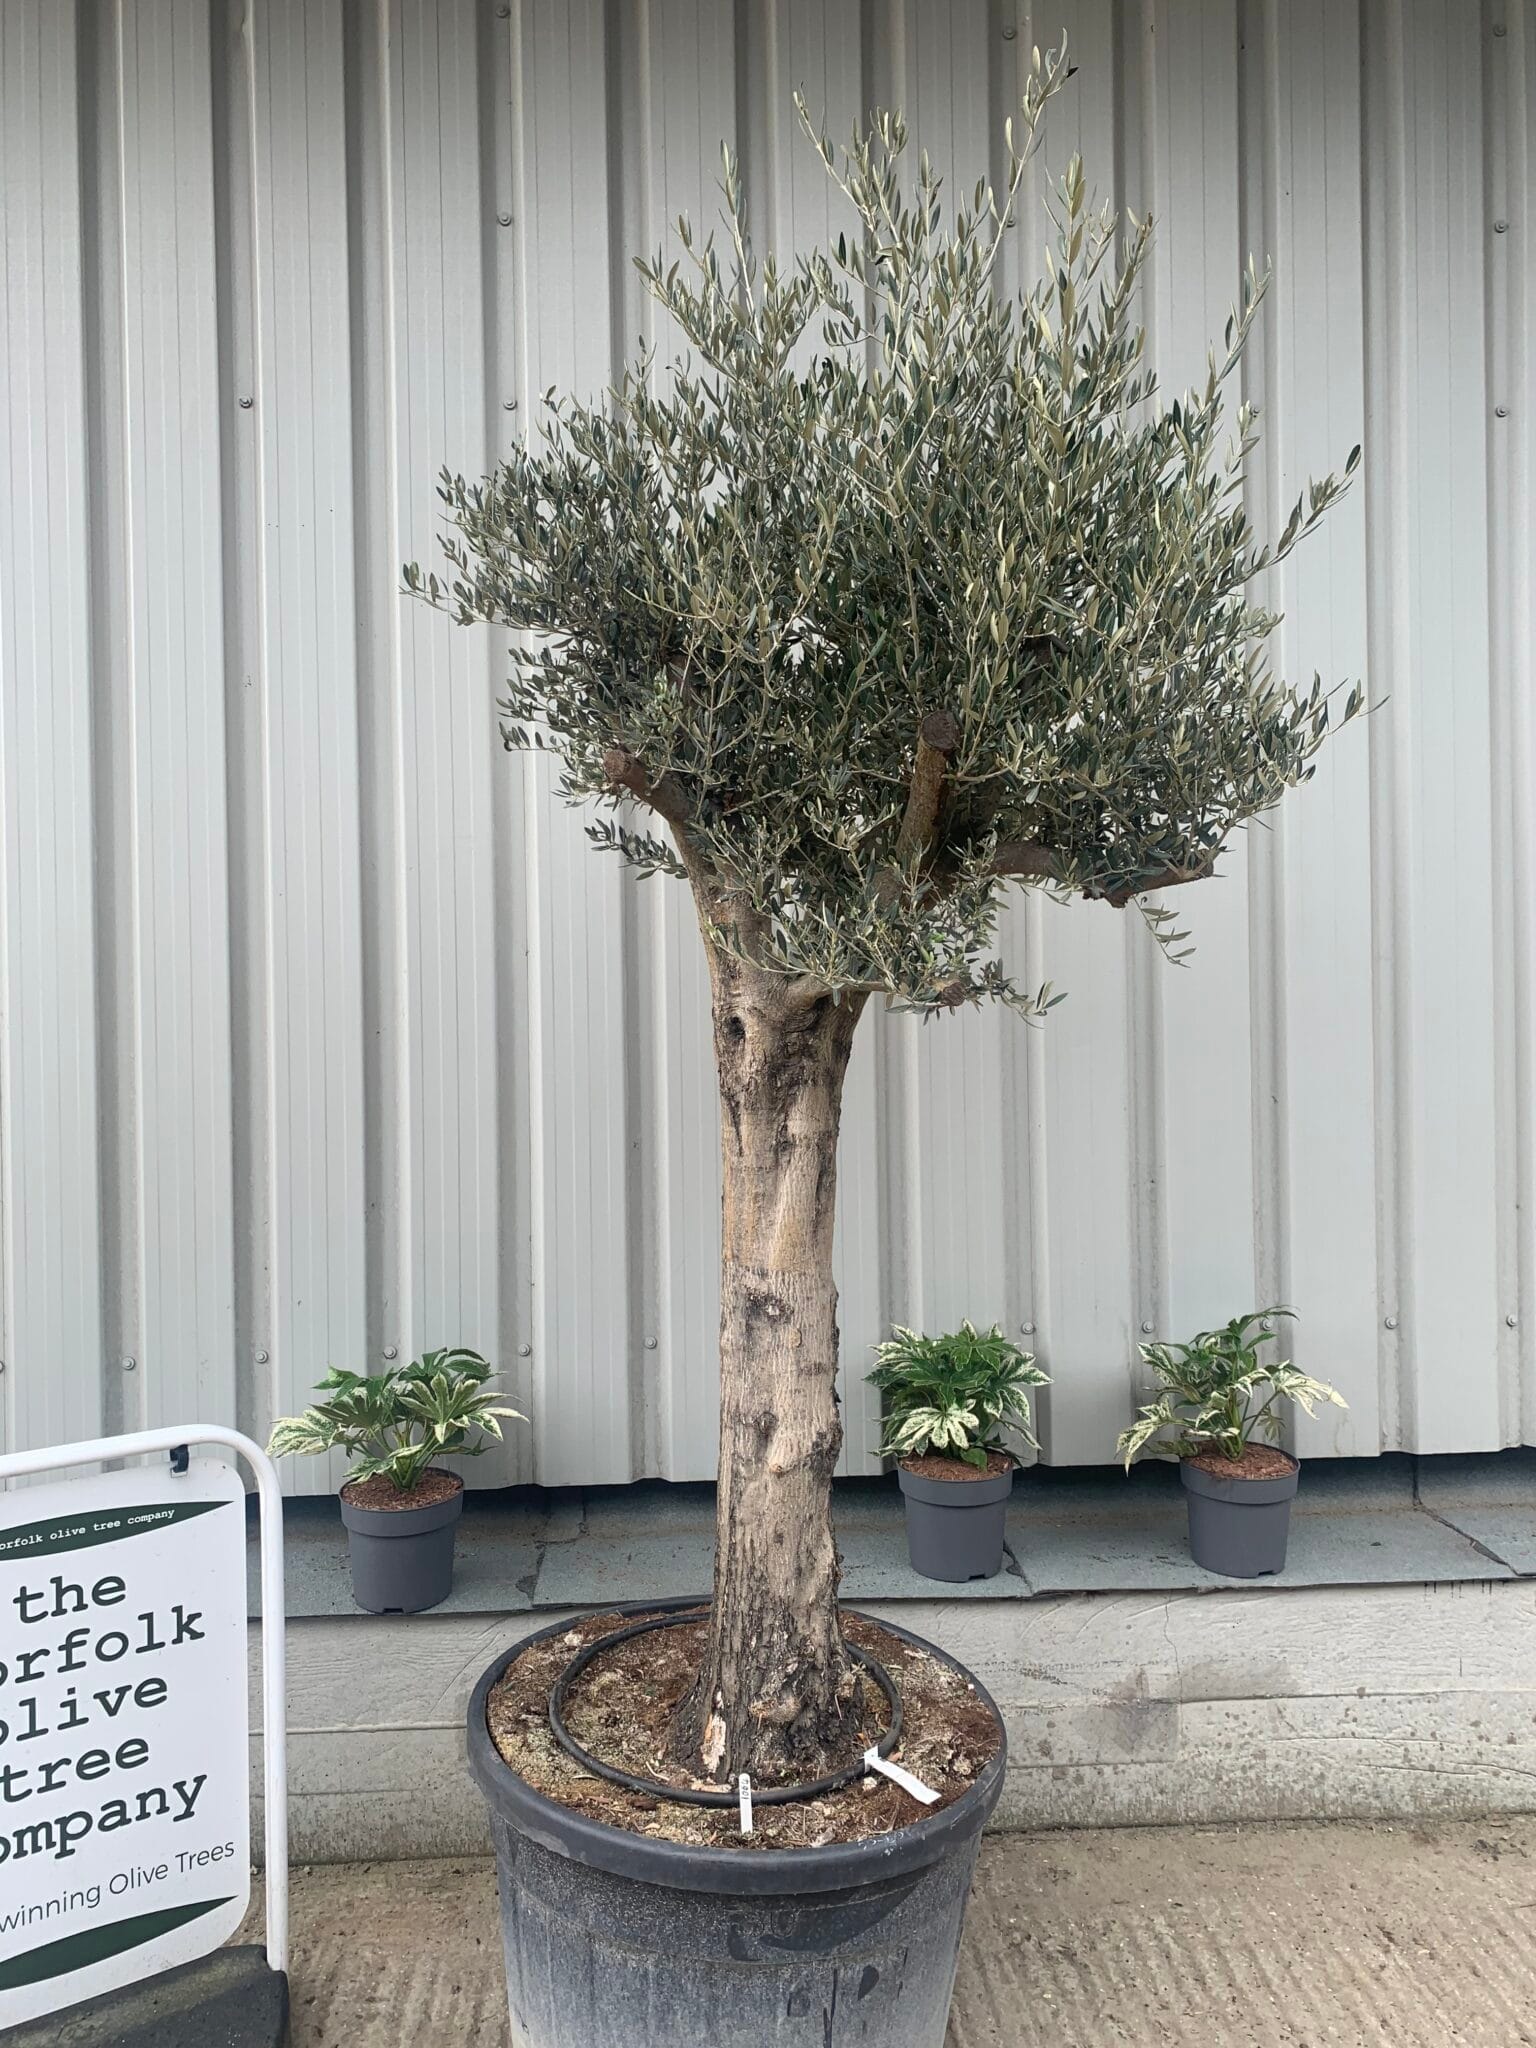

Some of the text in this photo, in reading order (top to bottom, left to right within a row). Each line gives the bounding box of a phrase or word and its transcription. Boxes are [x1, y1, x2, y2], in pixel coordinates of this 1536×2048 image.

[50, 1526, 86, 1540] olive
[93, 1519, 121, 1532] tree
[127, 1509, 175, 1525] company
[12, 1575, 126, 1624] the
[0, 1605, 206, 1687] rfolk
[0, 1677, 168, 1746] live
[0, 1738, 149, 1803] tree
[0, 1841, 235, 1933] winning Olive Trees
